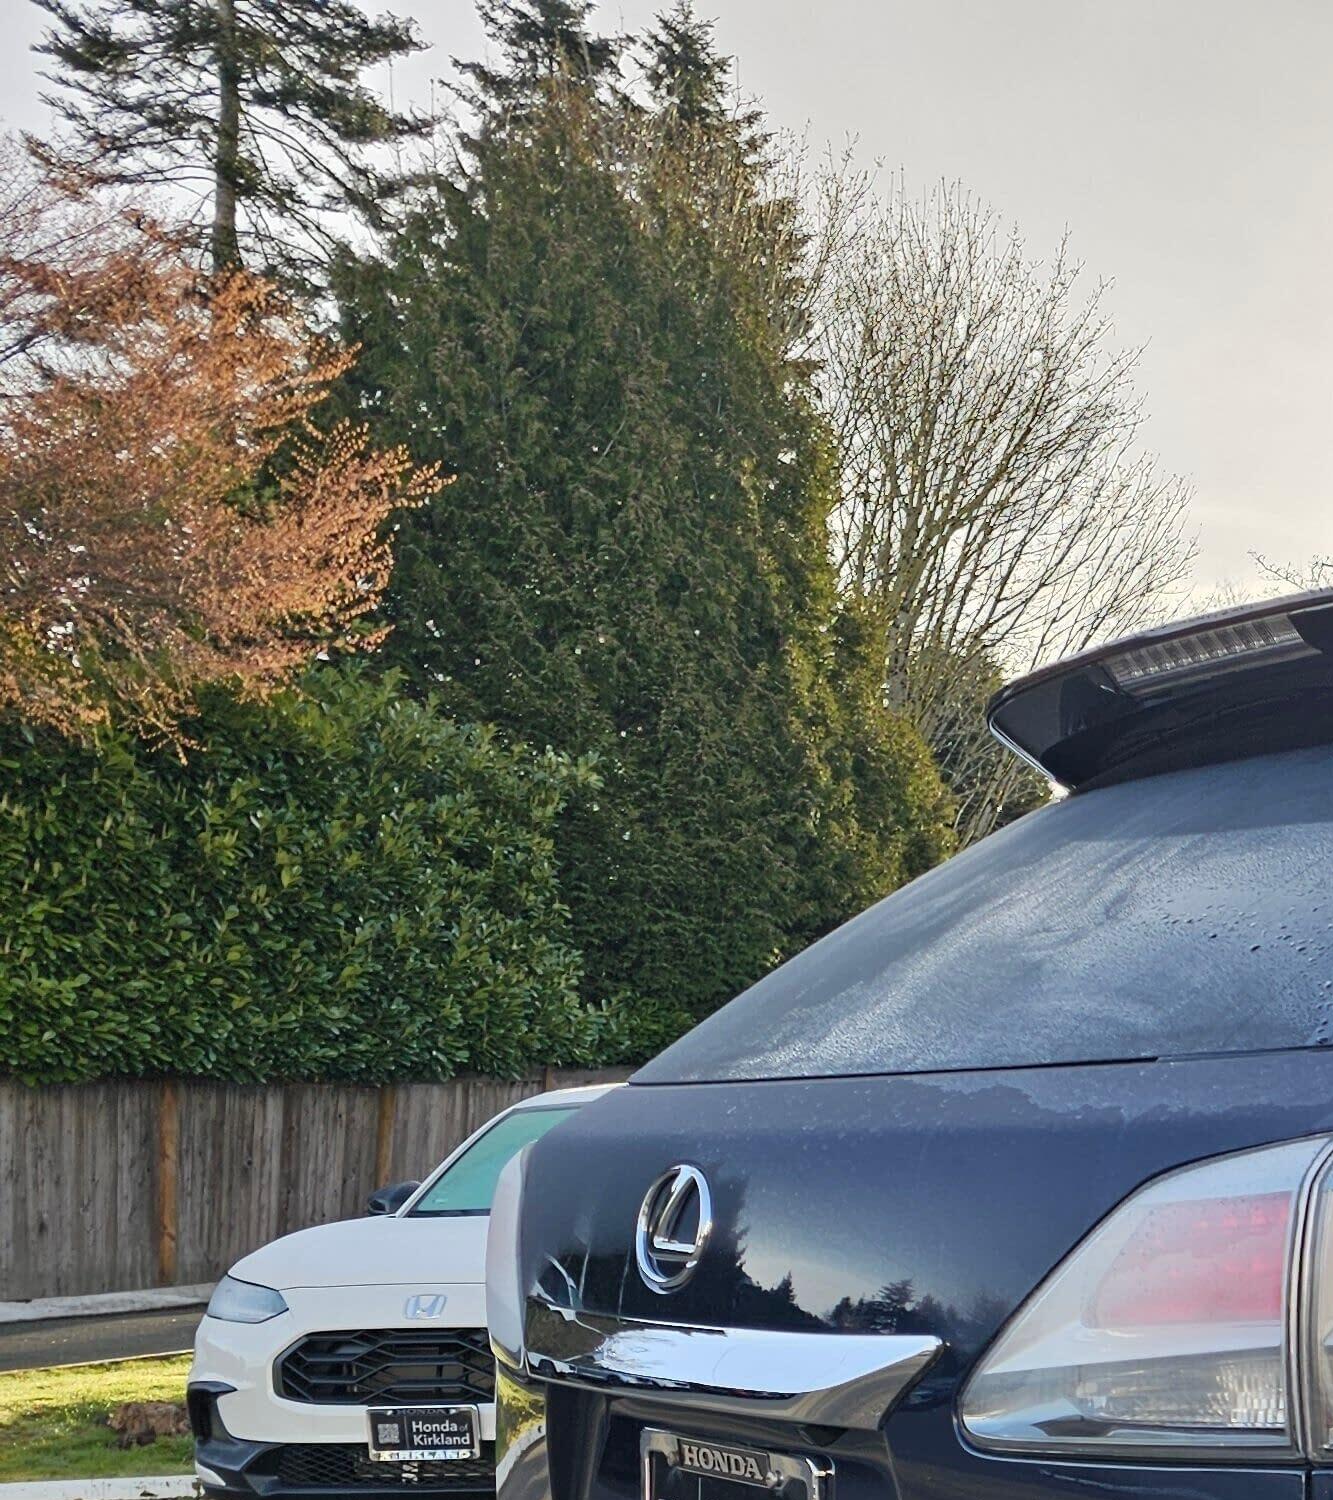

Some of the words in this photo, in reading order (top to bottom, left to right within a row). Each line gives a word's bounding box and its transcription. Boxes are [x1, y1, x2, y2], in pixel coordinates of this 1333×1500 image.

[411, 1419, 458, 1433] Honda
[458, 1423, 469, 1432] of
[412, 1433, 470, 1446] Kirkland
[683, 1445, 764, 1481] HONDA
